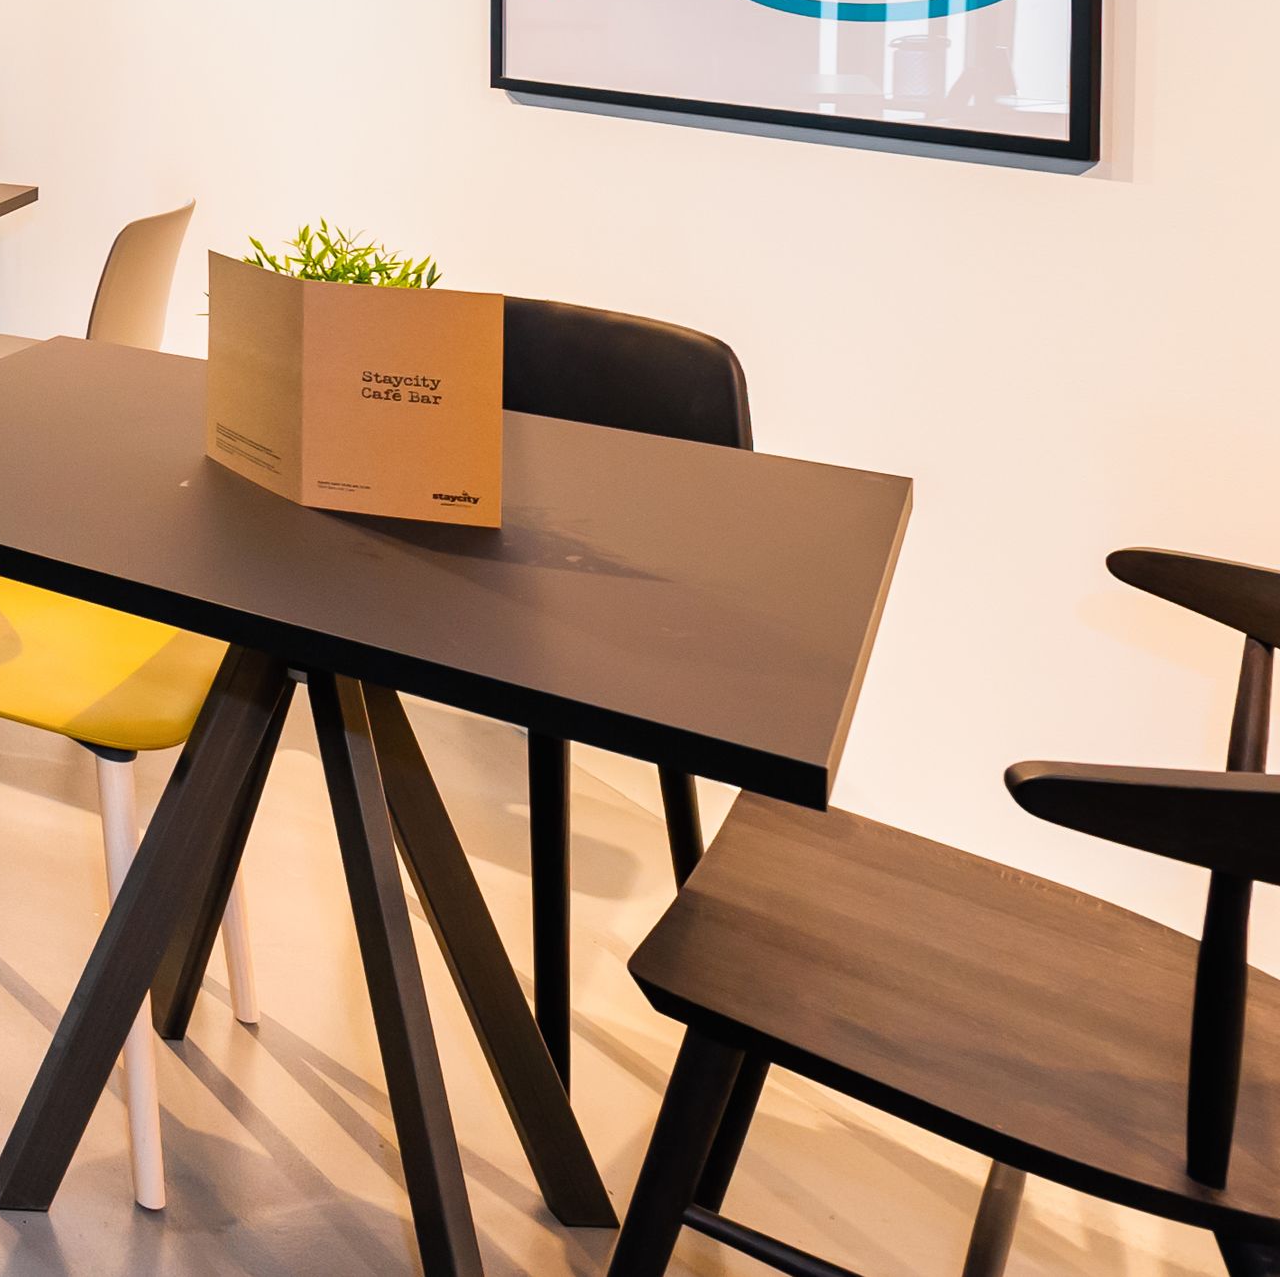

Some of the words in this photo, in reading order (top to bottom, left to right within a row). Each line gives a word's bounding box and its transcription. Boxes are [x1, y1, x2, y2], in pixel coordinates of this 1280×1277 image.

[361, 370, 441, 391] Staycity
[361, 387, 402, 402] Café
[408, 390, 442, 405] Bar
[432, 492, 480, 505] staycity
